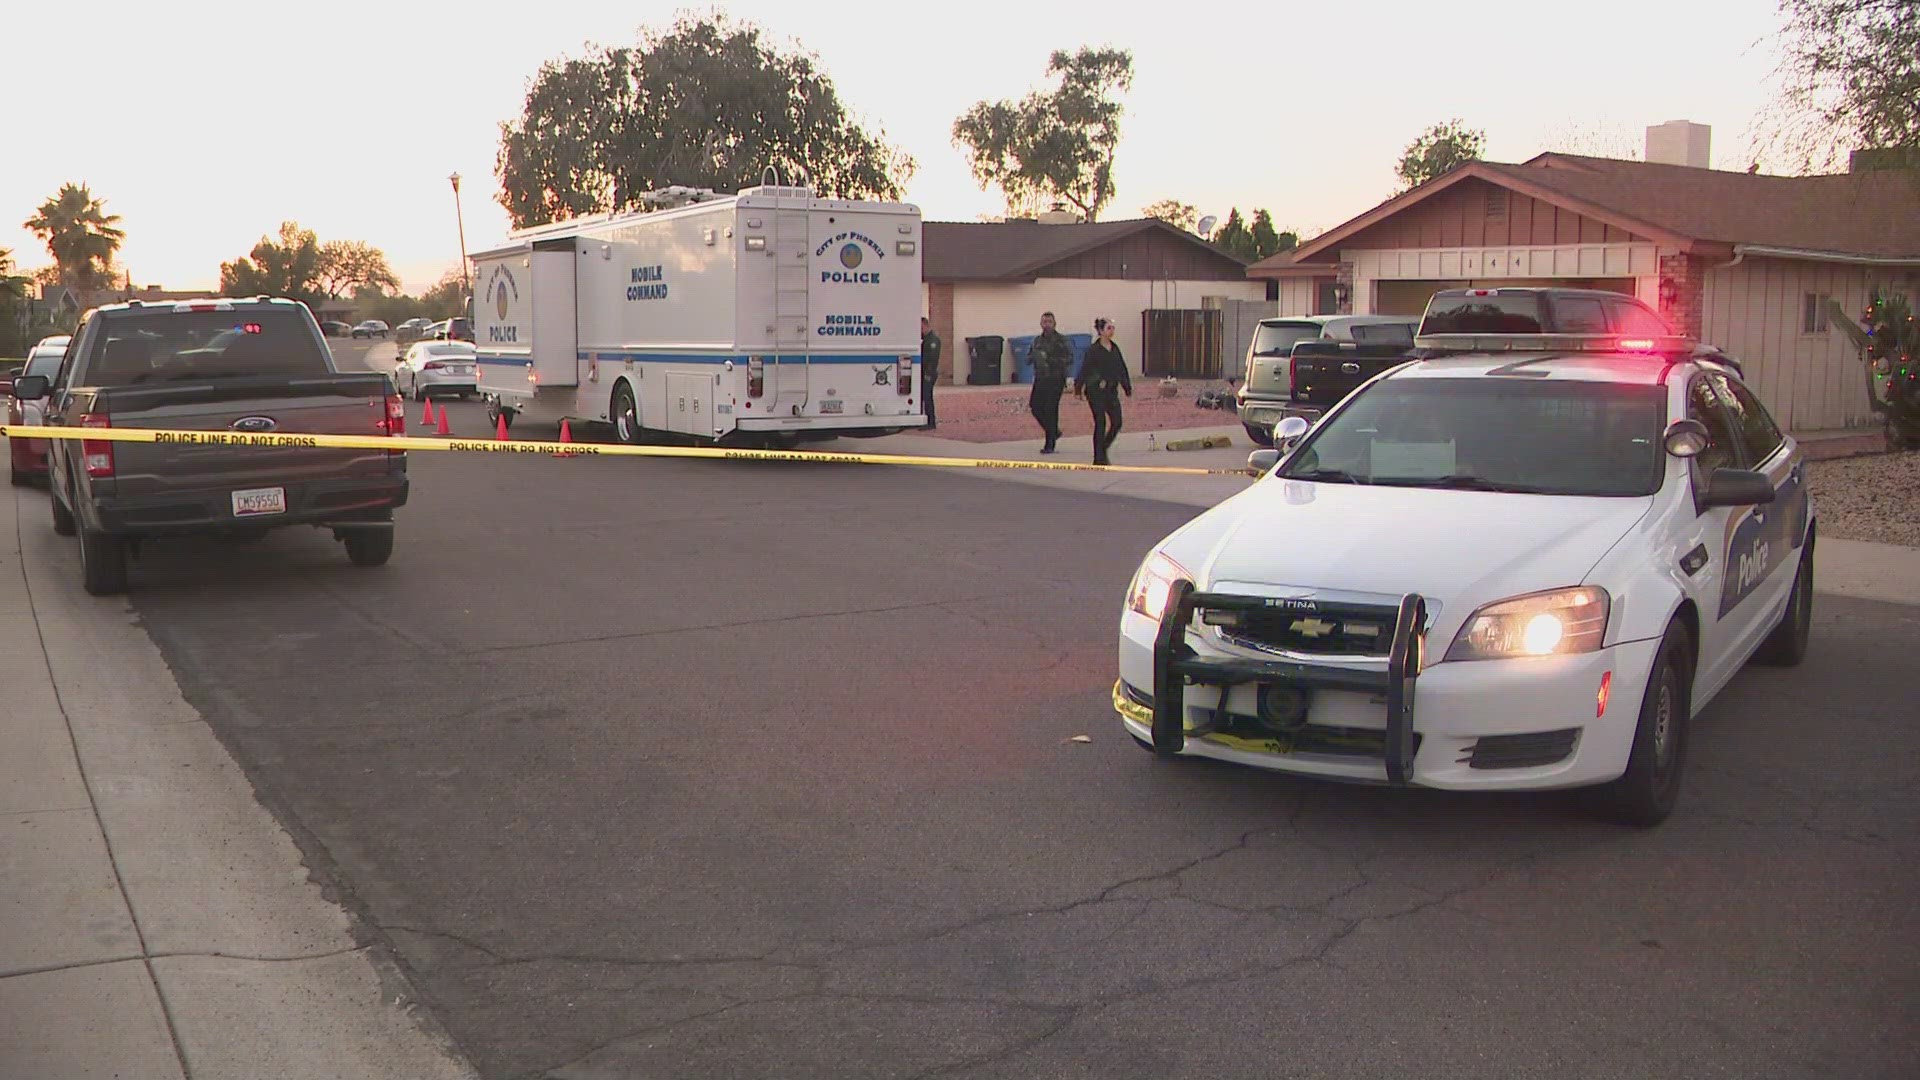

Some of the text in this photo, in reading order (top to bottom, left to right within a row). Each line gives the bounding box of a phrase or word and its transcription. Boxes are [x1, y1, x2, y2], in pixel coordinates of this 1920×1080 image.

[815, 238, 834, 256] CITY
[836, 233, 847, 241] OF
[631, 265, 663, 283] MOBILE
[821, 271, 880, 284] POLICE
[626, 283, 668, 301] COMMAND
[825, 315, 873, 325] MOBILE
[489, 325, 517, 342] POLICE
[817, 326, 881, 336] COMMAND
[155, 432, 316, 447] POLICE LINE DO NOT CROSS
[450, 442, 488, 451] POLICE
[493, 444, 517, 452] LINE
[521, 445, 535, 453] DO
[1737, 538, 1769, 595] Police
